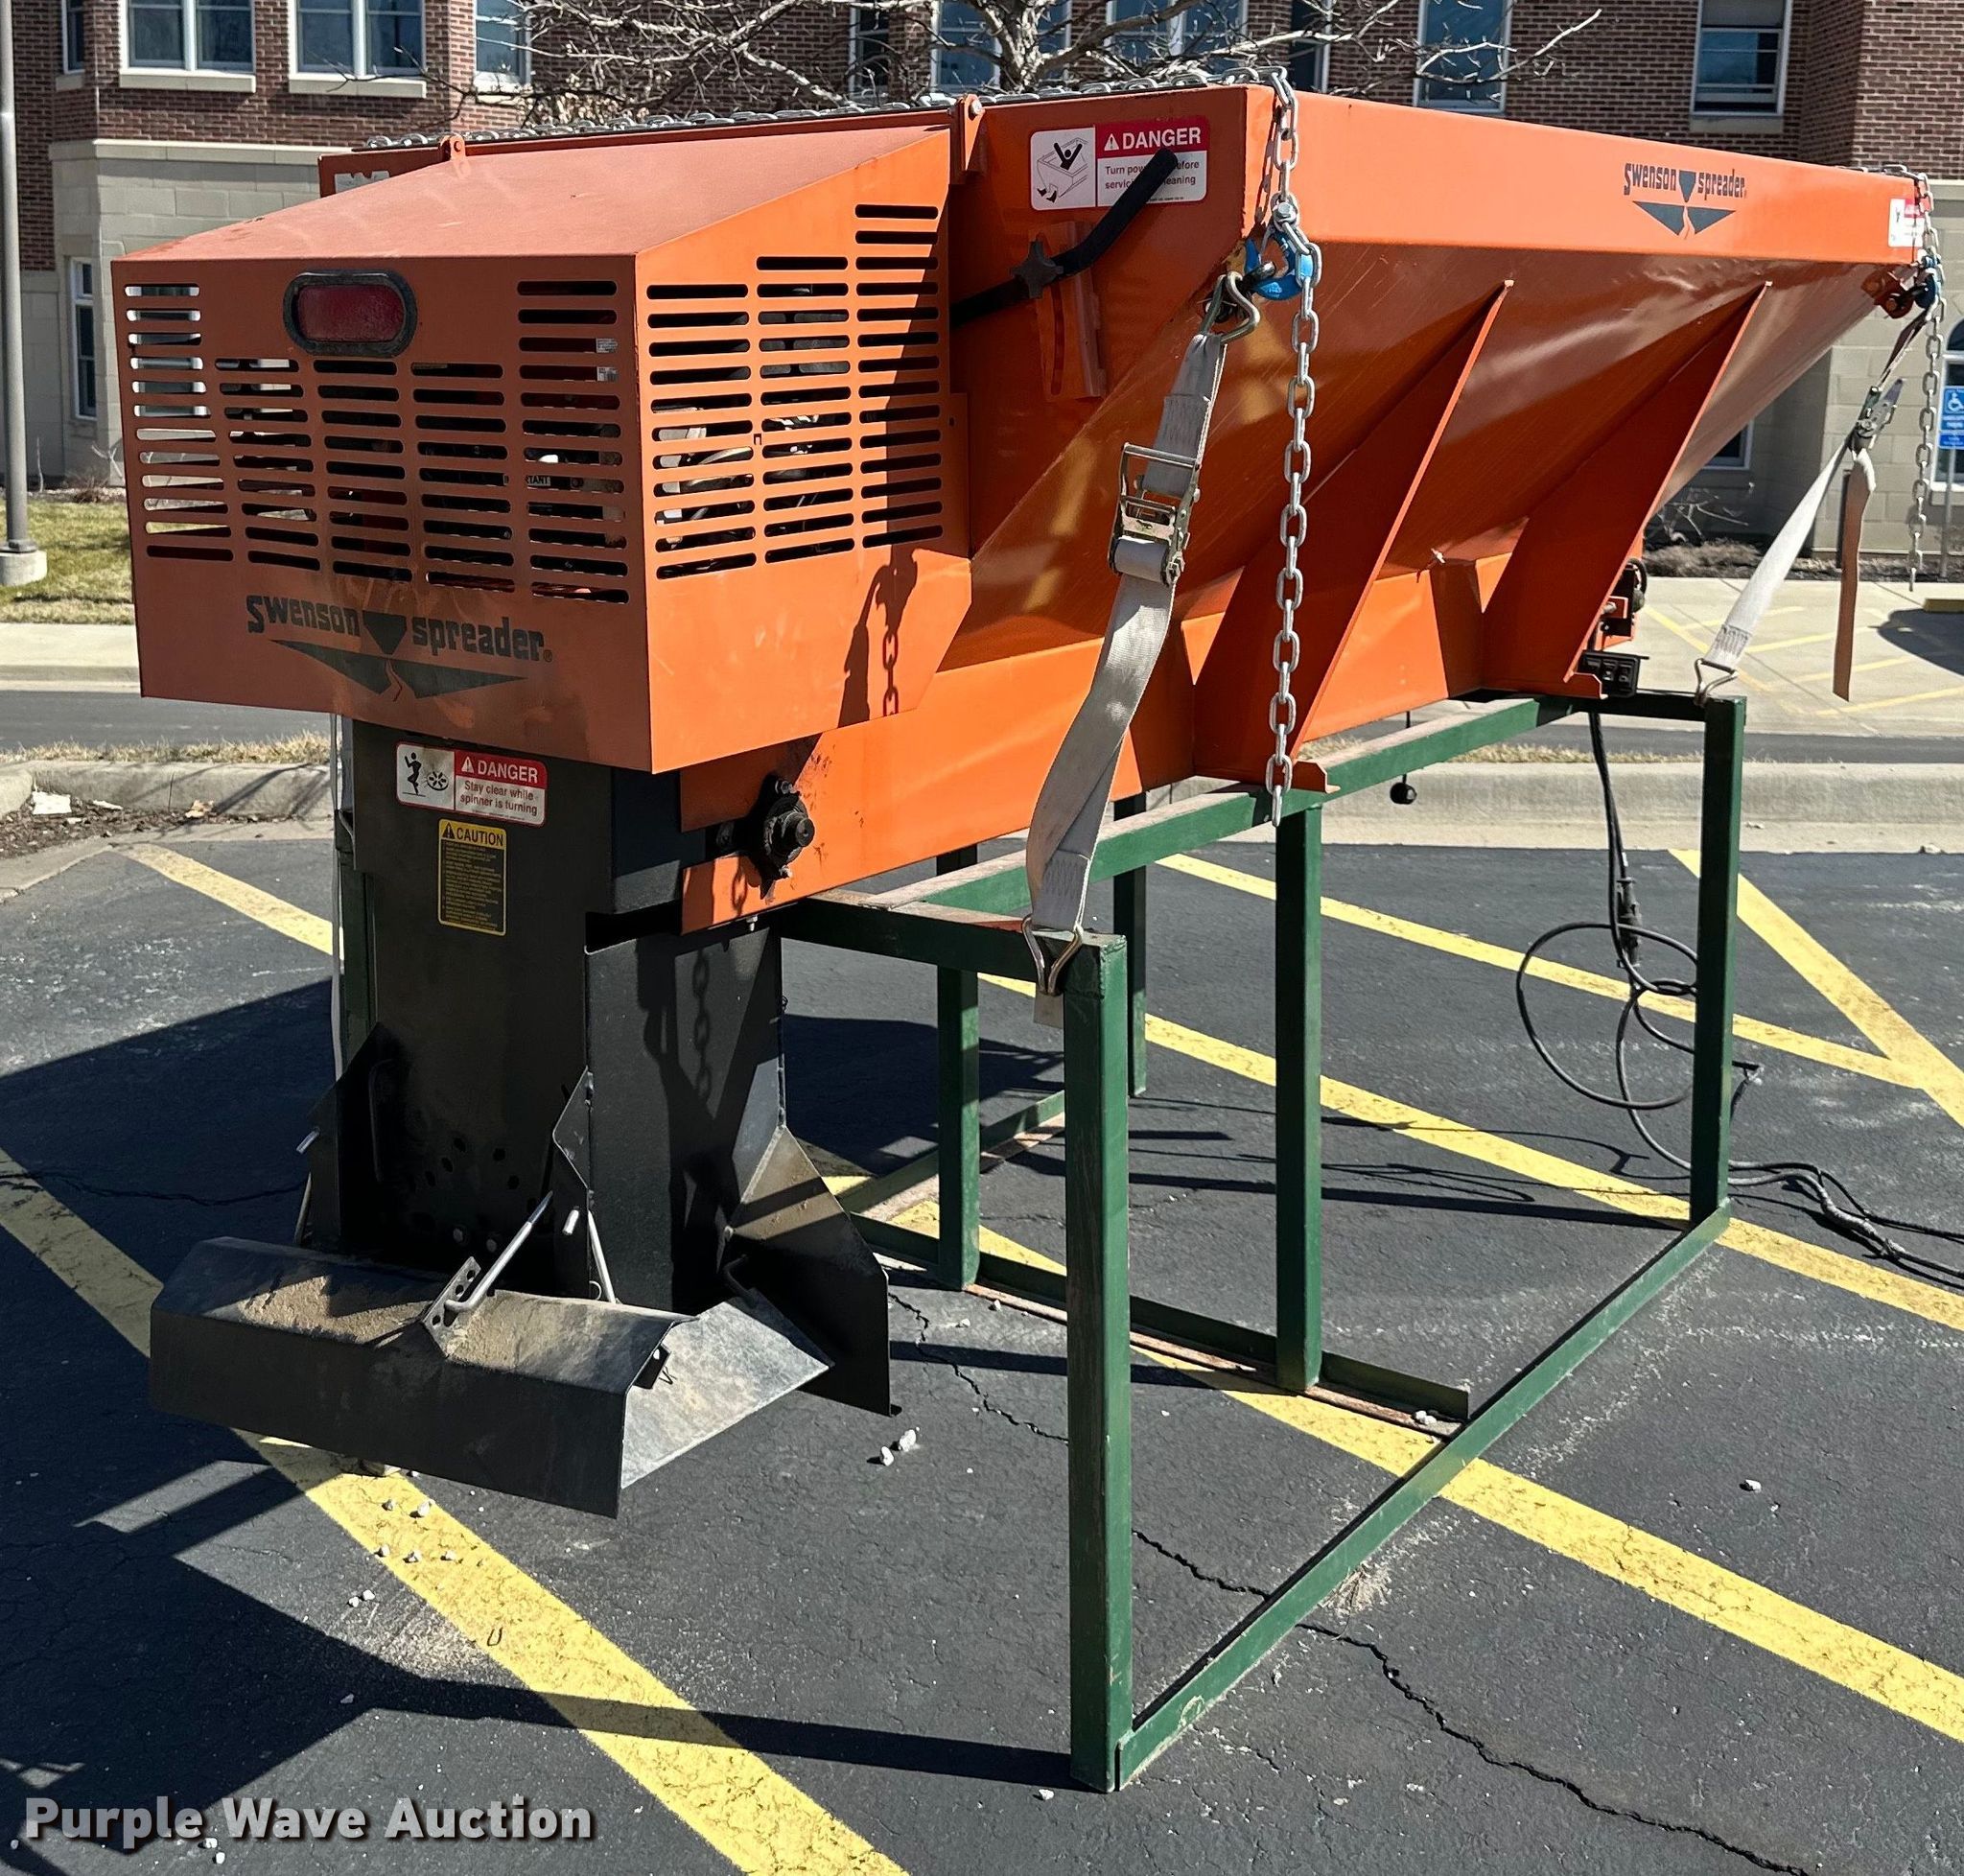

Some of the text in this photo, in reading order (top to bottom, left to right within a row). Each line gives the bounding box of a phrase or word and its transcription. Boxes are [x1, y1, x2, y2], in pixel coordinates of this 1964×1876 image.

[1122, 127, 1201, 150] DANGER
[1106, 165, 1126, 175] Turn
[1177, 160, 1200, 170] efore
[478, 760, 538, 783] DANGER
[464, 780, 534, 801] Stay clear while
[459, 794, 494, 808] spinner
[495, 798, 503, 809] is
[504, 800, 538, 816] turning
[456, 827, 504, 846] CAUTION
